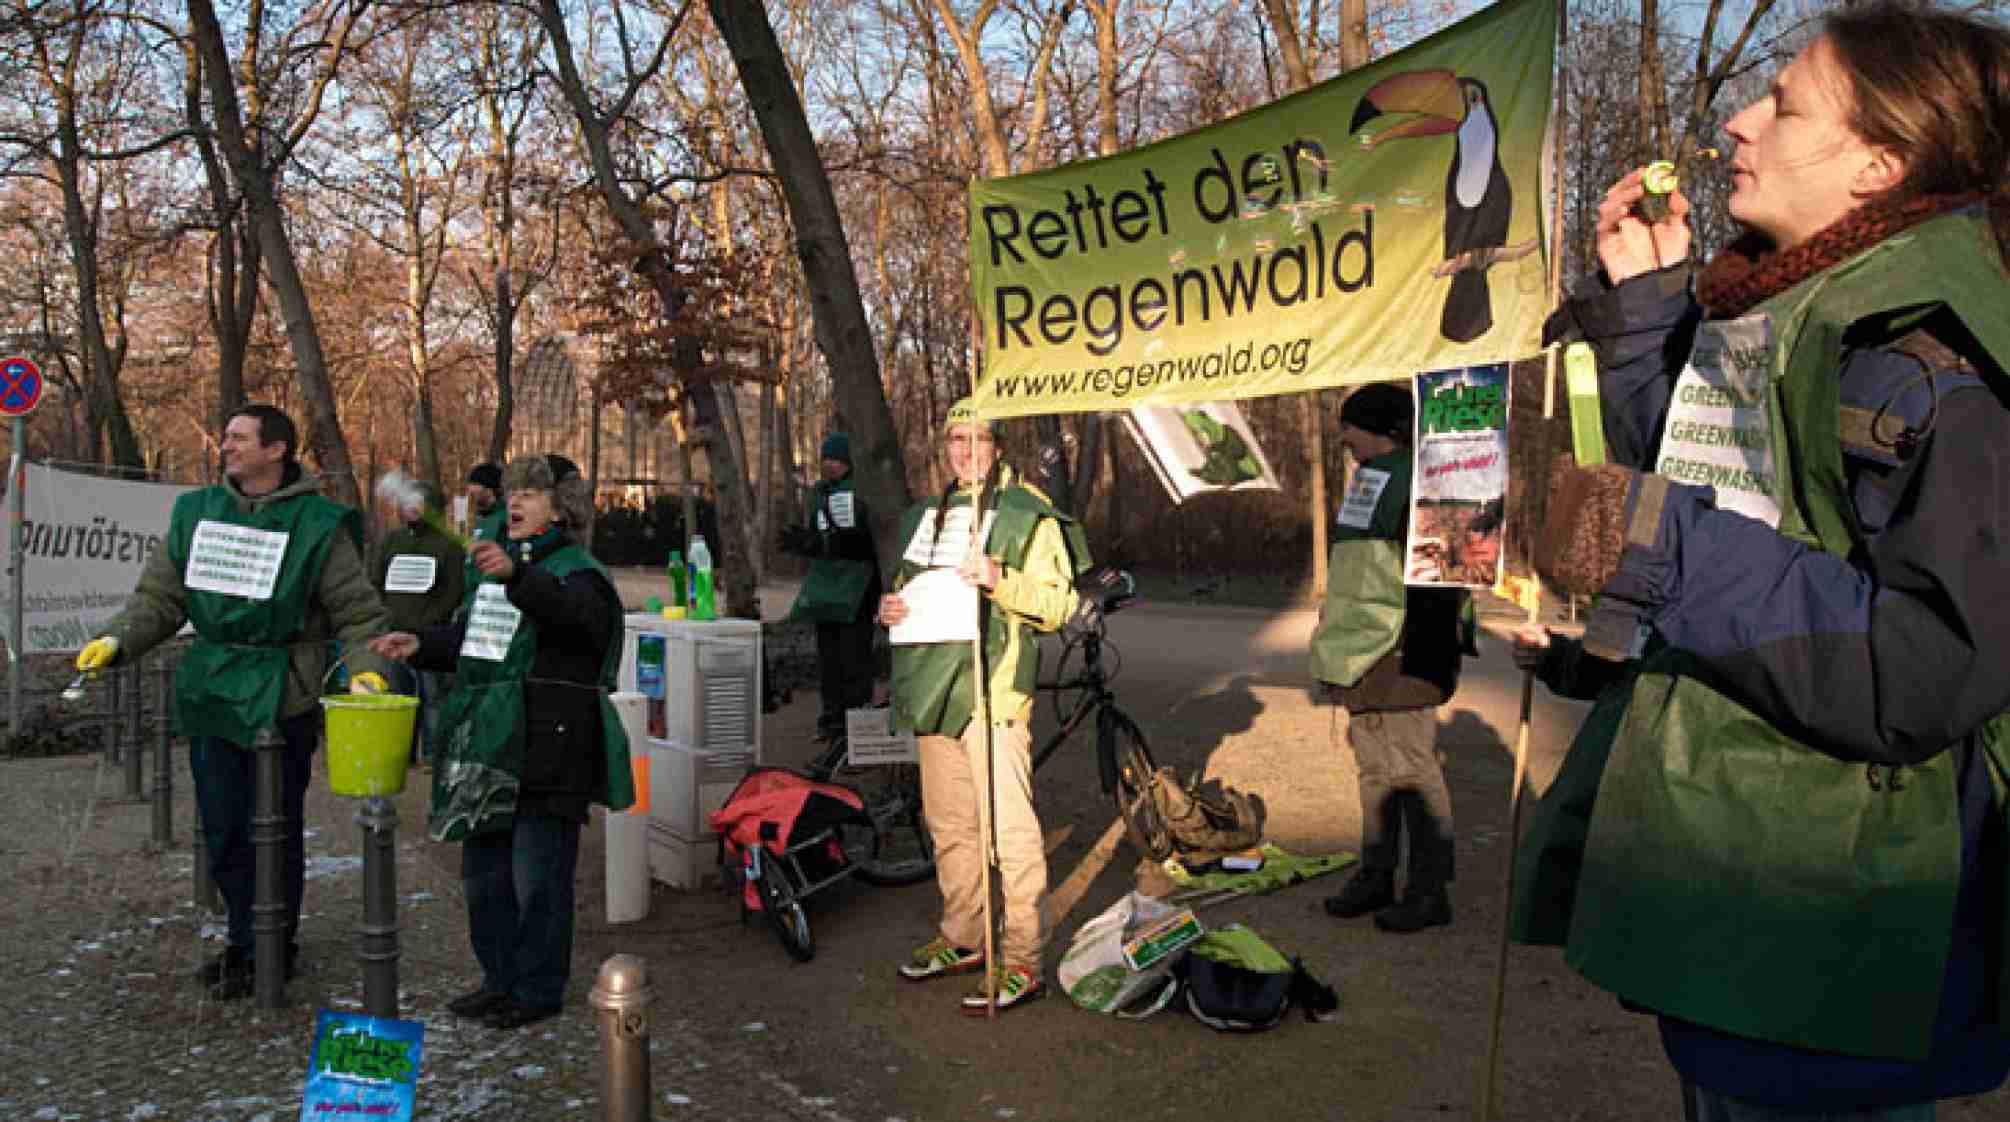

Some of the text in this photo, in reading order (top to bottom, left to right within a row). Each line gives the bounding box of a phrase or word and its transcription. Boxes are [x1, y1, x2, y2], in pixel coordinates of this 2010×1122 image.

[981, 138, 1328, 267] Rettet den
[994, 209, 1376, 356] Regenwald
[994, 337, 1313, 398] www.regenwald.org
